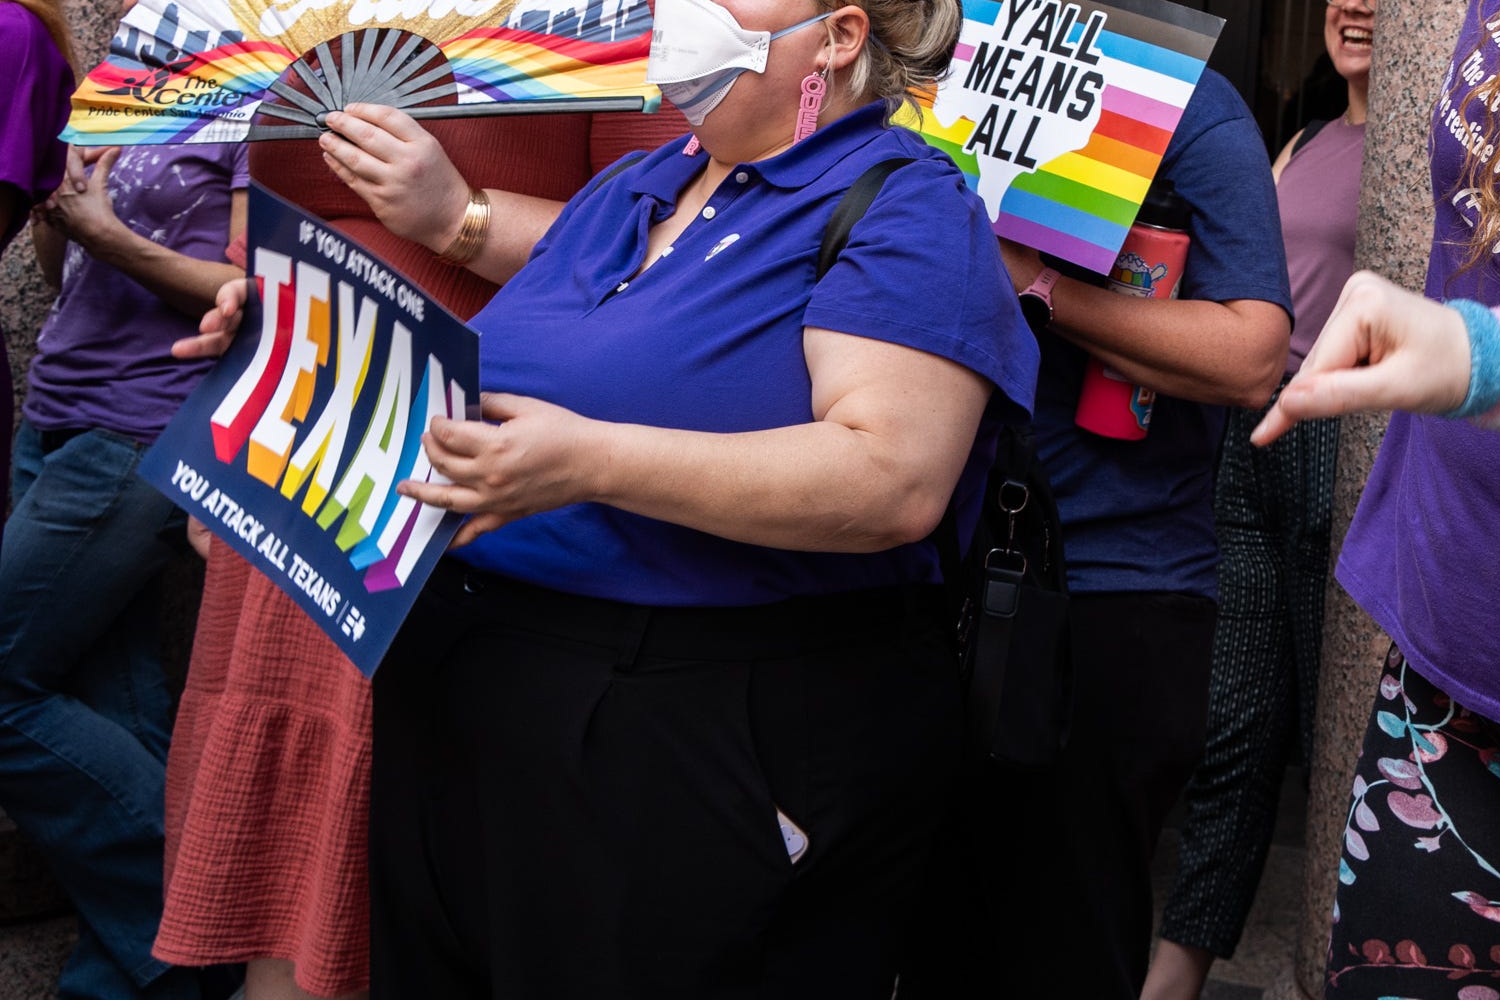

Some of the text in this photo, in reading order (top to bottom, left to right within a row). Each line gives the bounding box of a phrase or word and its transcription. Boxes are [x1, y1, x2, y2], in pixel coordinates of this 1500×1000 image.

[154, 87, 250, 107] Center
[184, 76, 218, 90] The
[962, 41, 1104, 122] MEANS
[1461, 49, 1484, 86] The
[88, 106, 119, 117] Pride
[124, 107, 166, 117] Center
[170, 108, 192, 118] San
[795, 73, 826, 146] QUEE
[965, 103, 1042, 169] ALL
[1445, 109, 1493, 163] realize
[299, 220, 425, 322] IF YOU ATTACK ONE
[211, 247, 466, 592] TEXAN
[171, 459, 341, 618] YOU ATTACK ALL TEXANS
